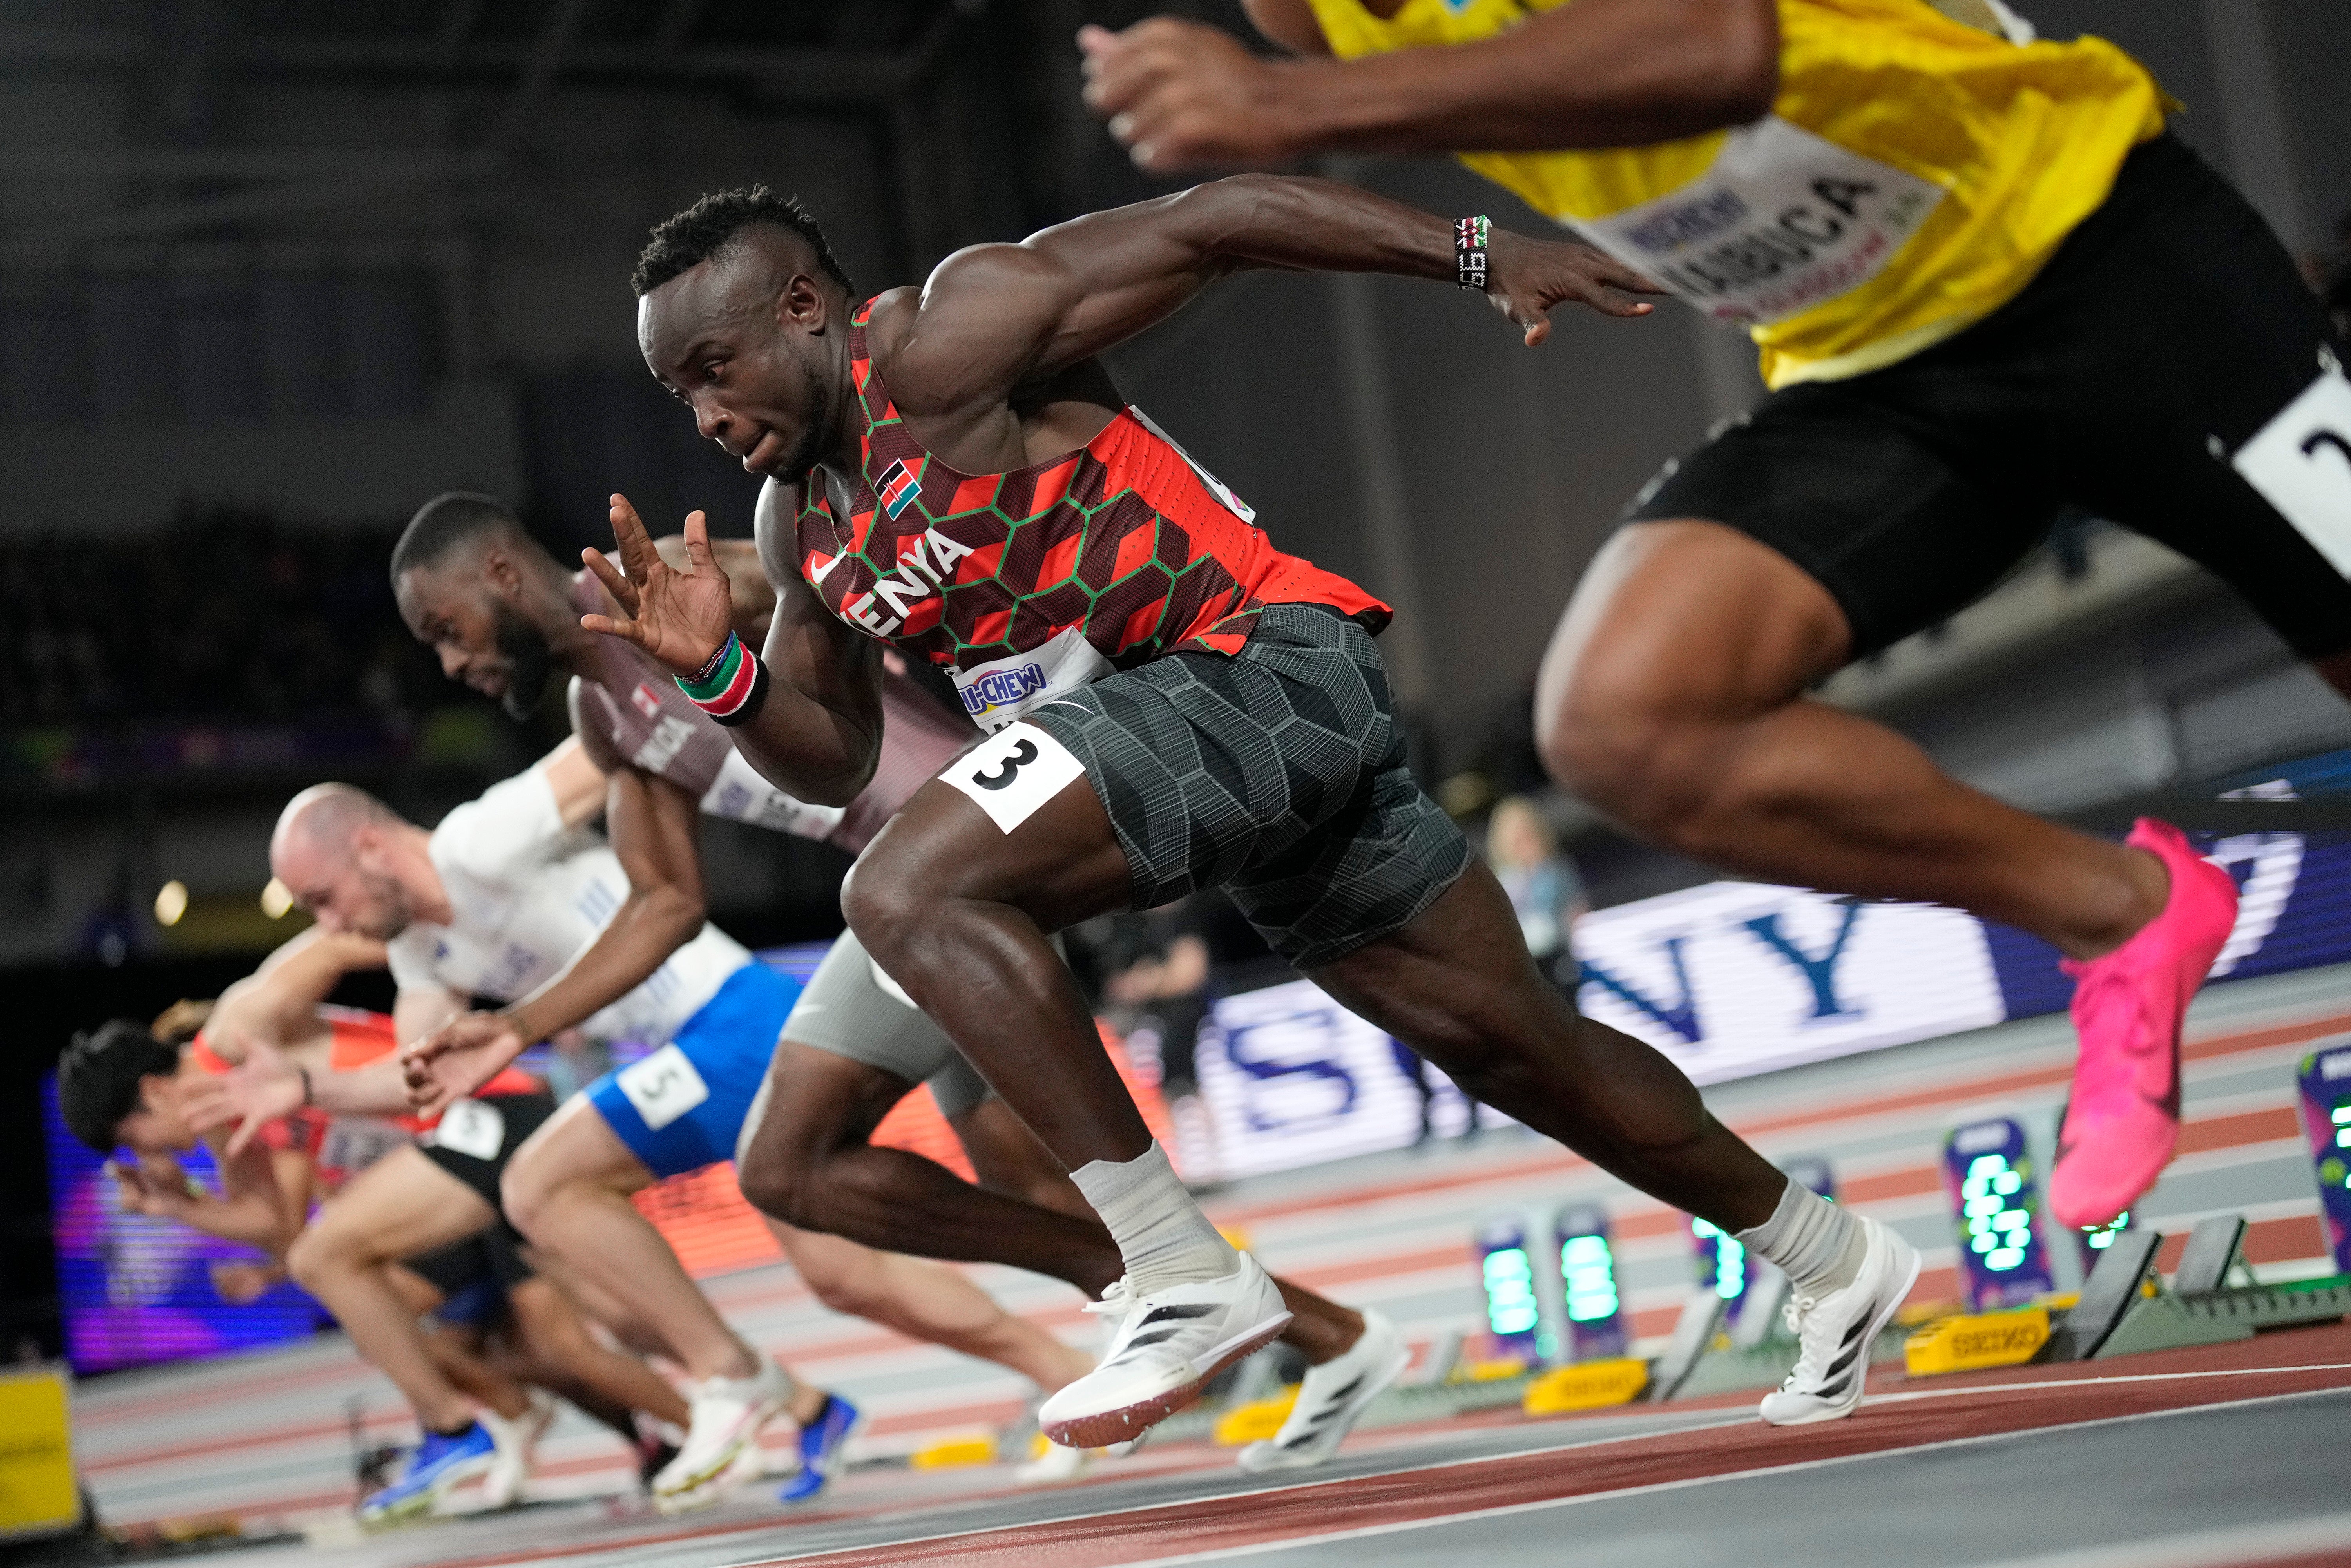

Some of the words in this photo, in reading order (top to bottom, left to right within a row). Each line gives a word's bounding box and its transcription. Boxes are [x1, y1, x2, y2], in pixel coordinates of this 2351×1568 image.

[840, 527, 975, 637] ENYA
[972, 739, 1038, 791] 3
[1226, 901, 1866, 1132] SNY
[639, 1068, 681, 1102] 5
